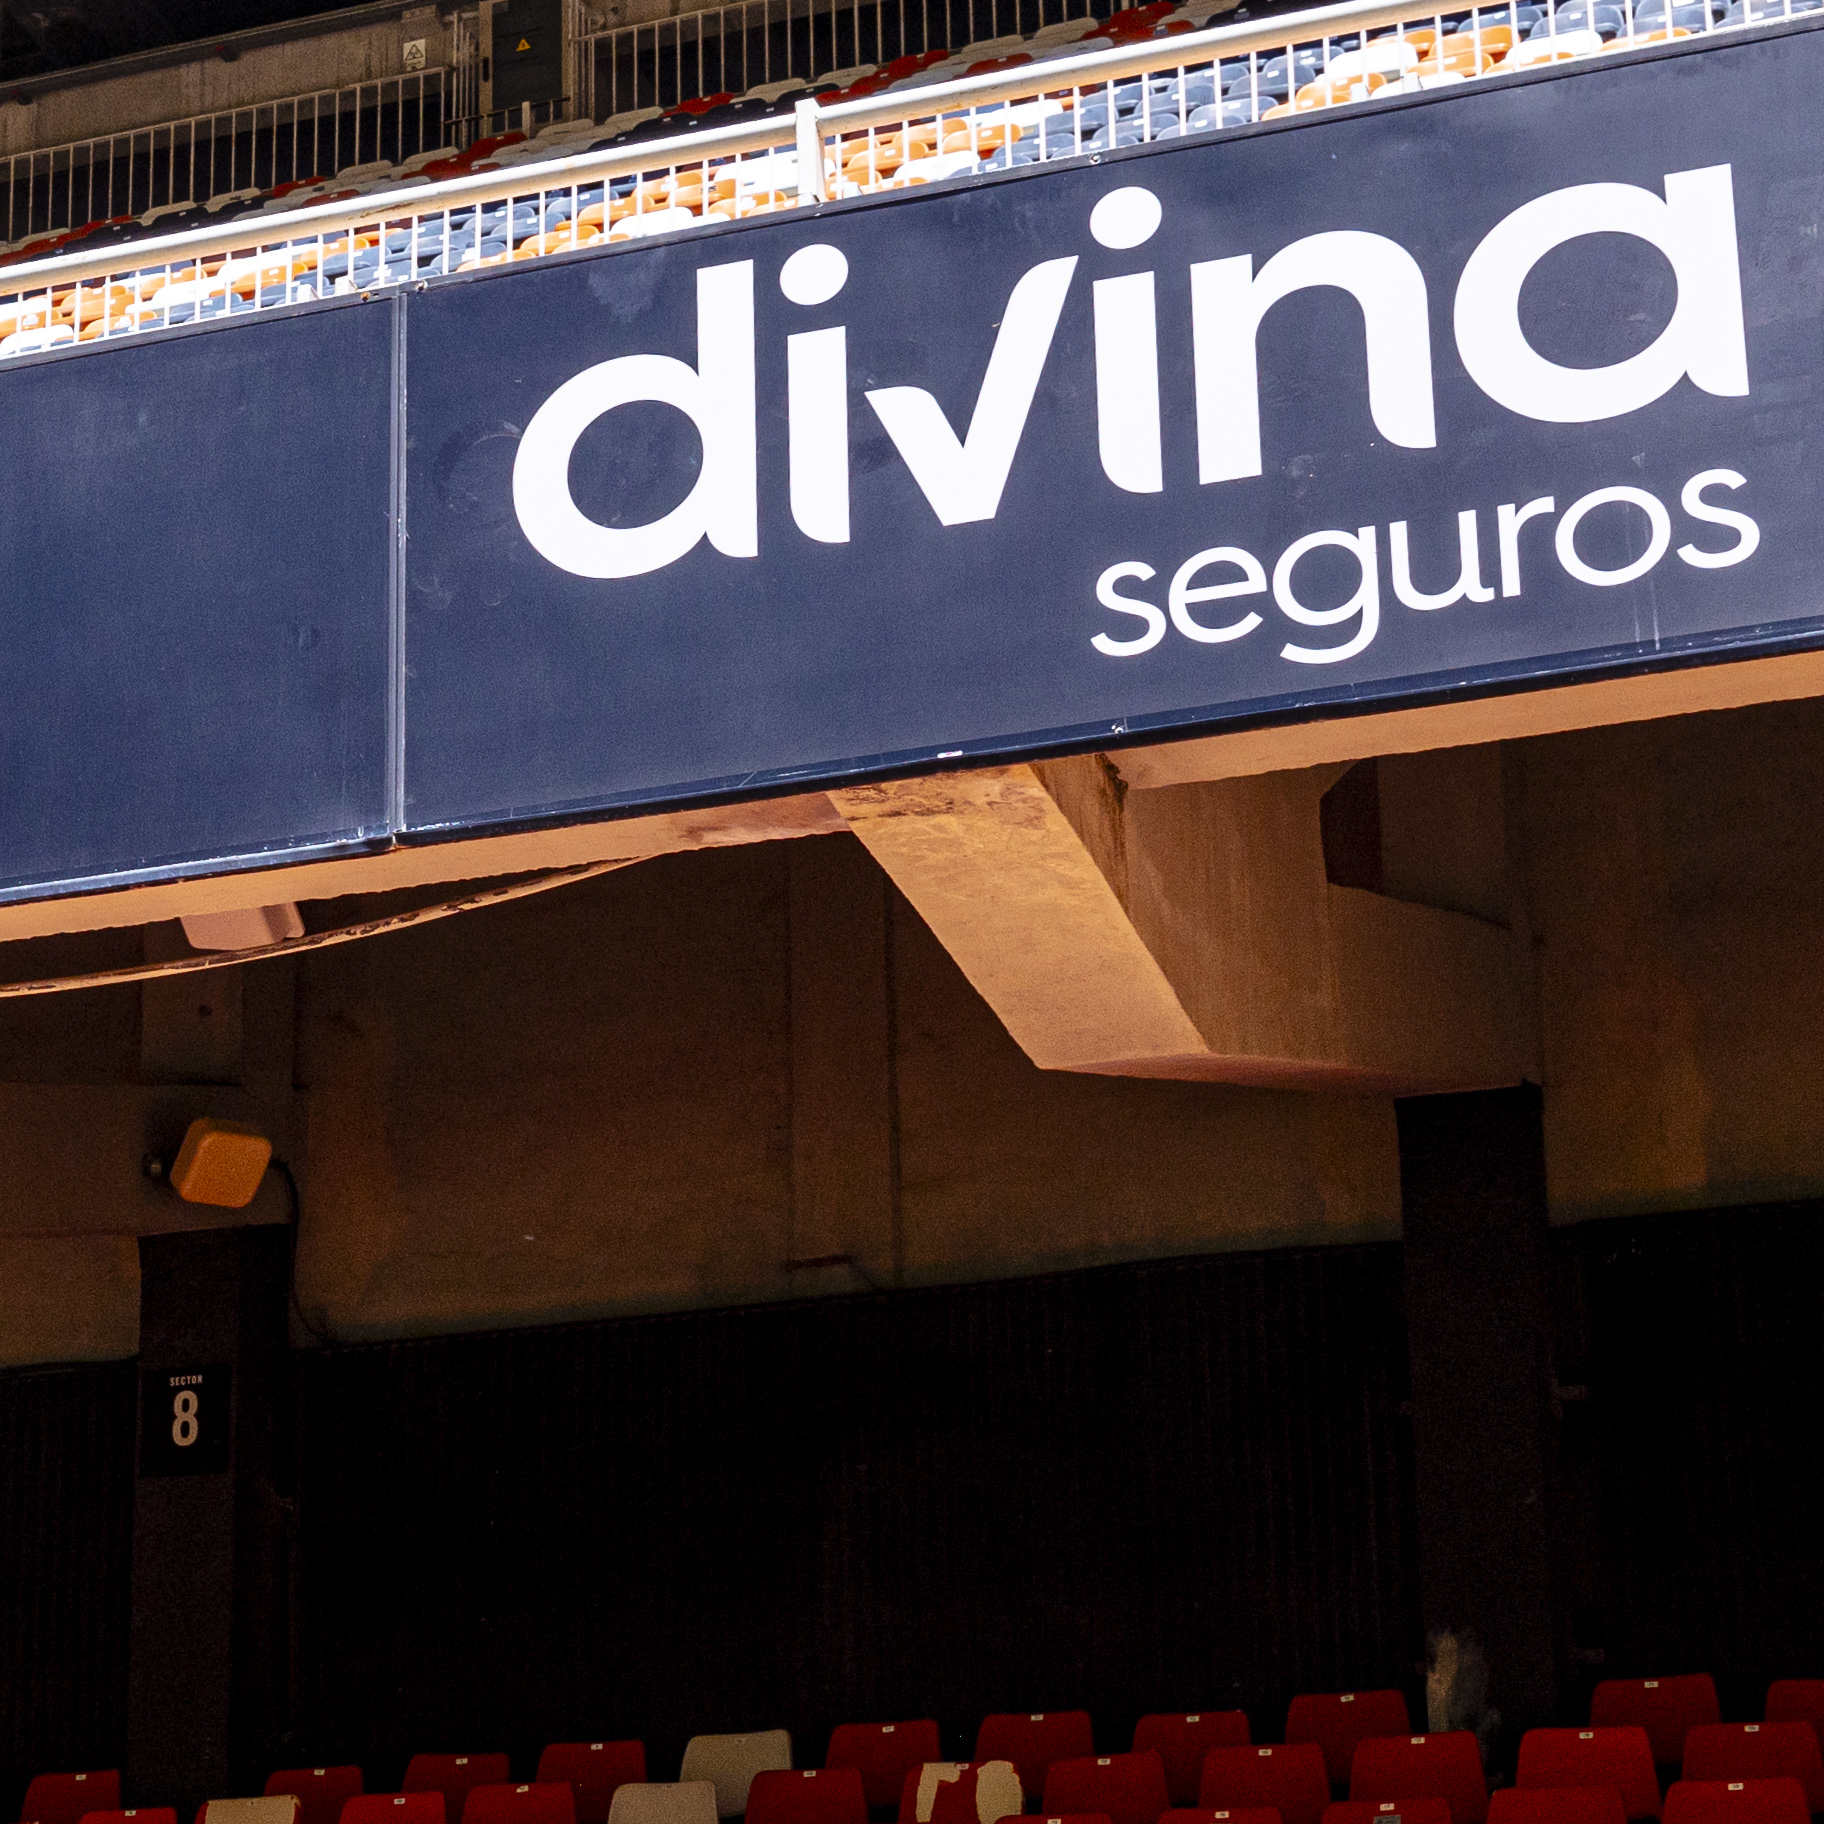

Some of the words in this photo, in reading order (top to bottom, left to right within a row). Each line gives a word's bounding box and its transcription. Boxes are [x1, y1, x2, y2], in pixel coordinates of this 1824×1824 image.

[513, 164, 1749, 578] divina
[1091, 469, 1760, 663] seguros
[170, 1375, 203, 1386] SECTOR
[172, 1390, 199, 1447] 8
